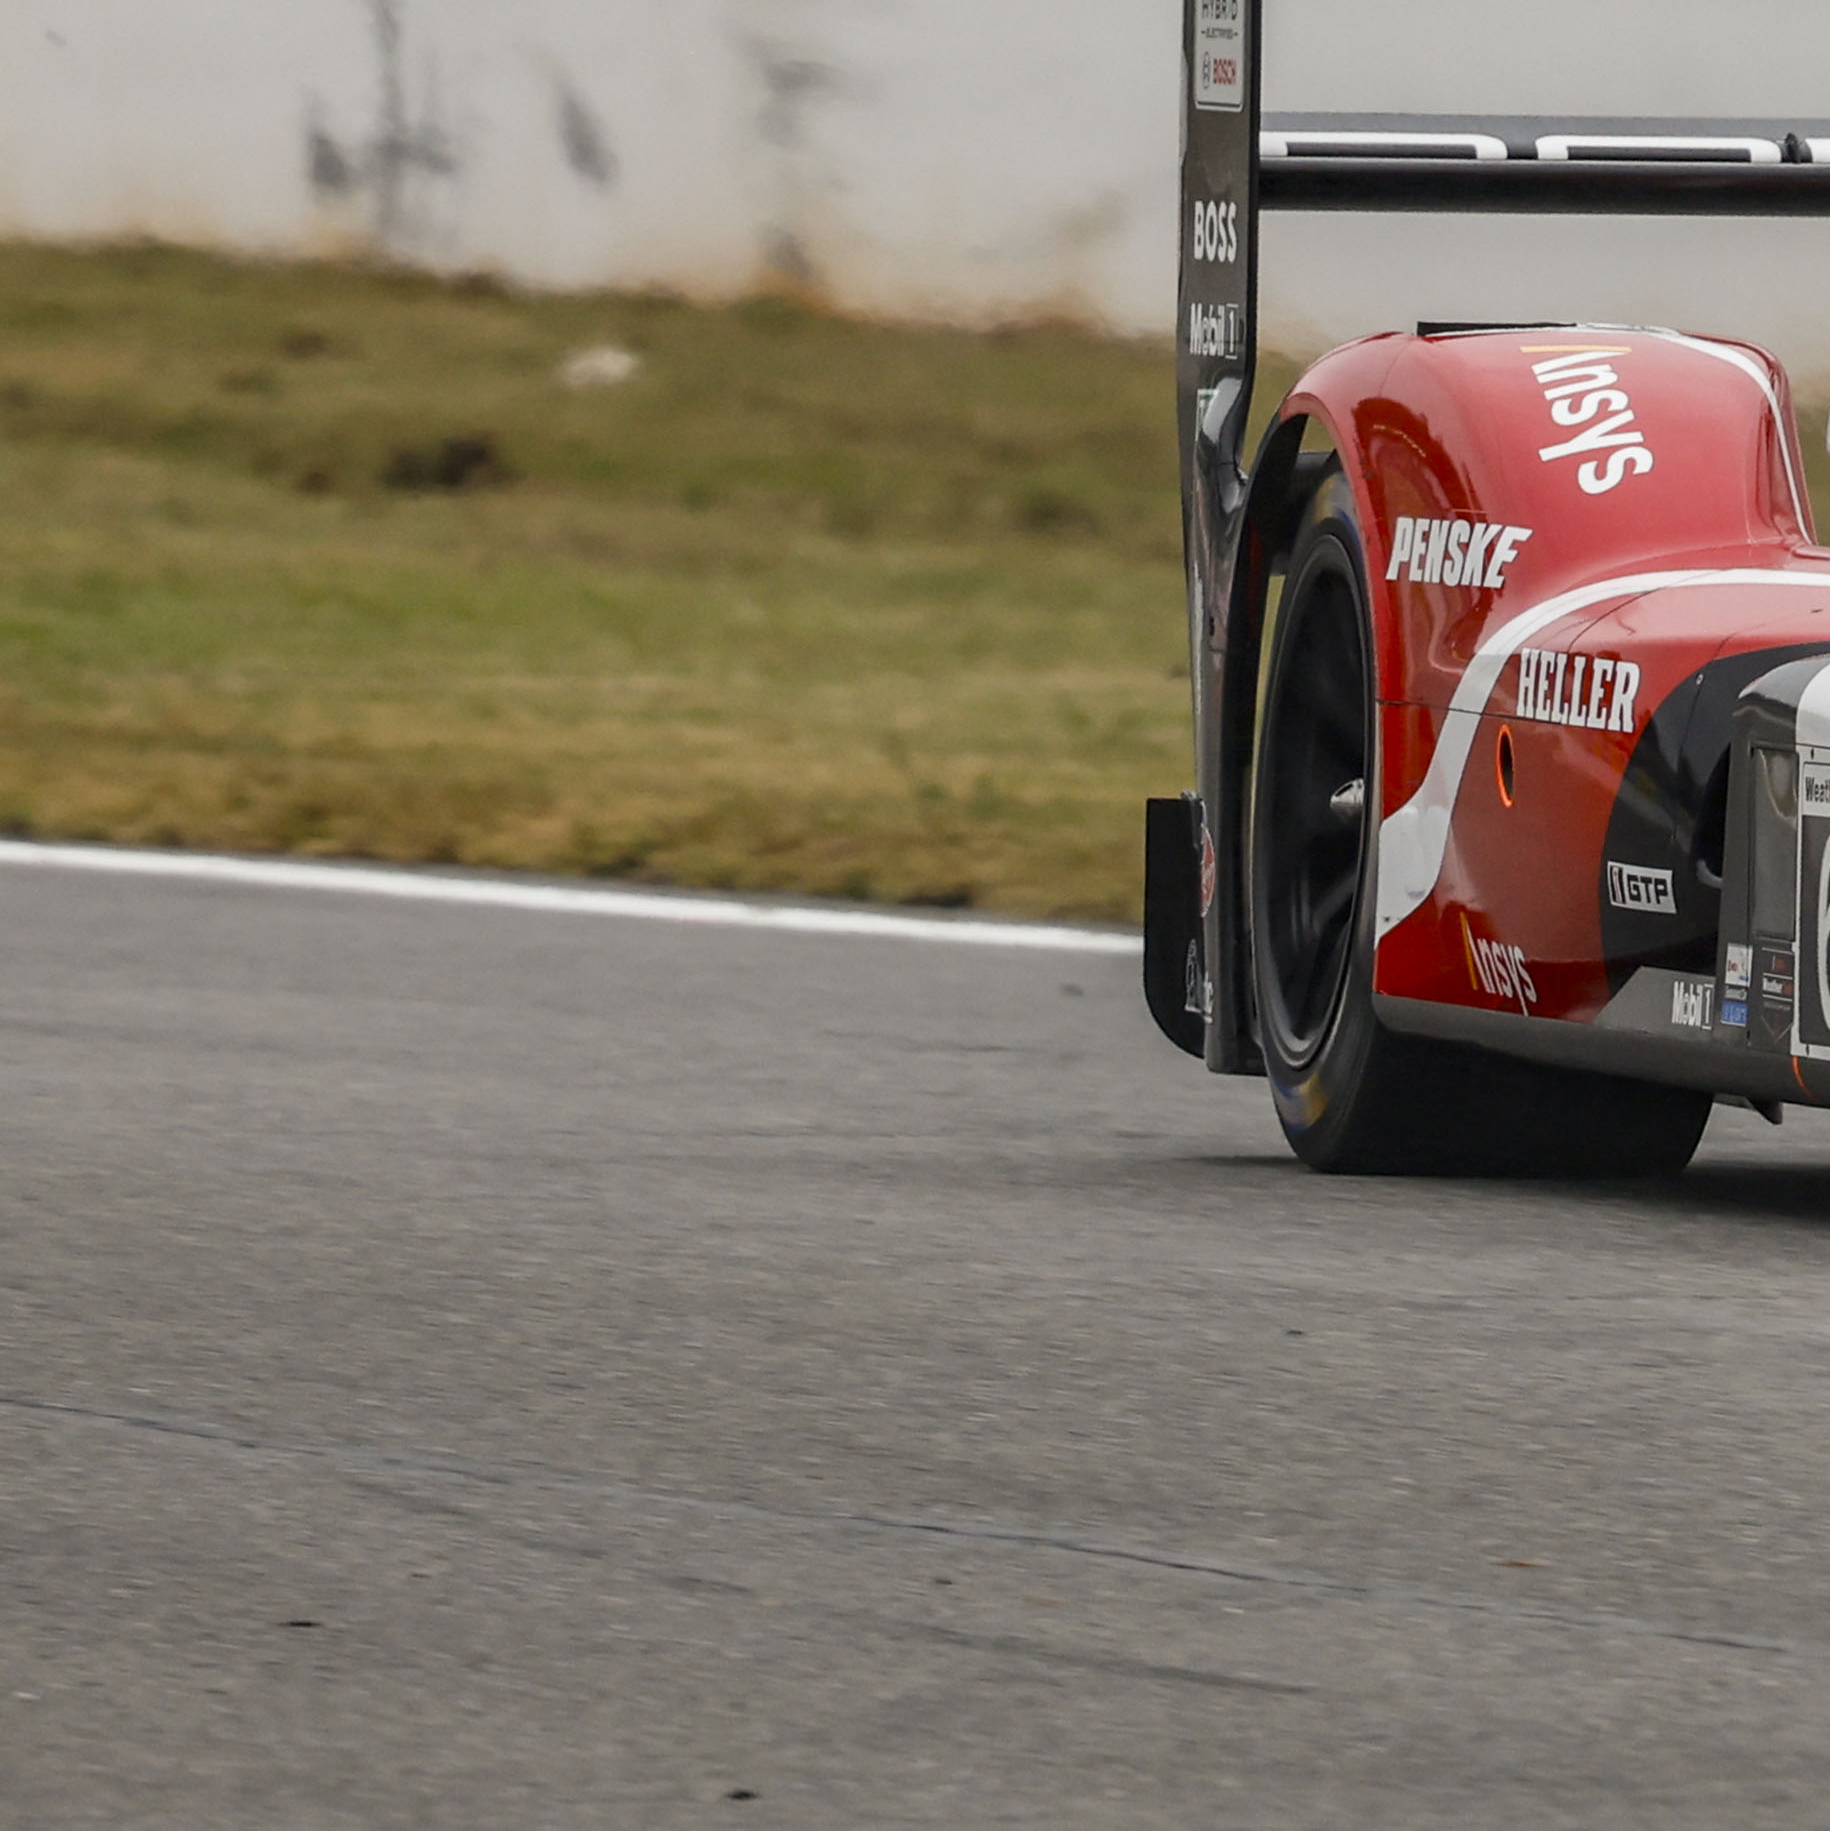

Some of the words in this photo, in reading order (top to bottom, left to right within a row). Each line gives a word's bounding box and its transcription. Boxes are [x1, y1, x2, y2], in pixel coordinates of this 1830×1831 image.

[1193, 200, 1238, 264] BOSS
[1189, 302, 1226, 357] Mobil
[1384, 515, 1534, 589] PENSKE
[1515, 646, 1641, 735] HELLER
[1625, 873, 1670, 906] GTP
[1671, 979, 1703, 1027] Mobil
